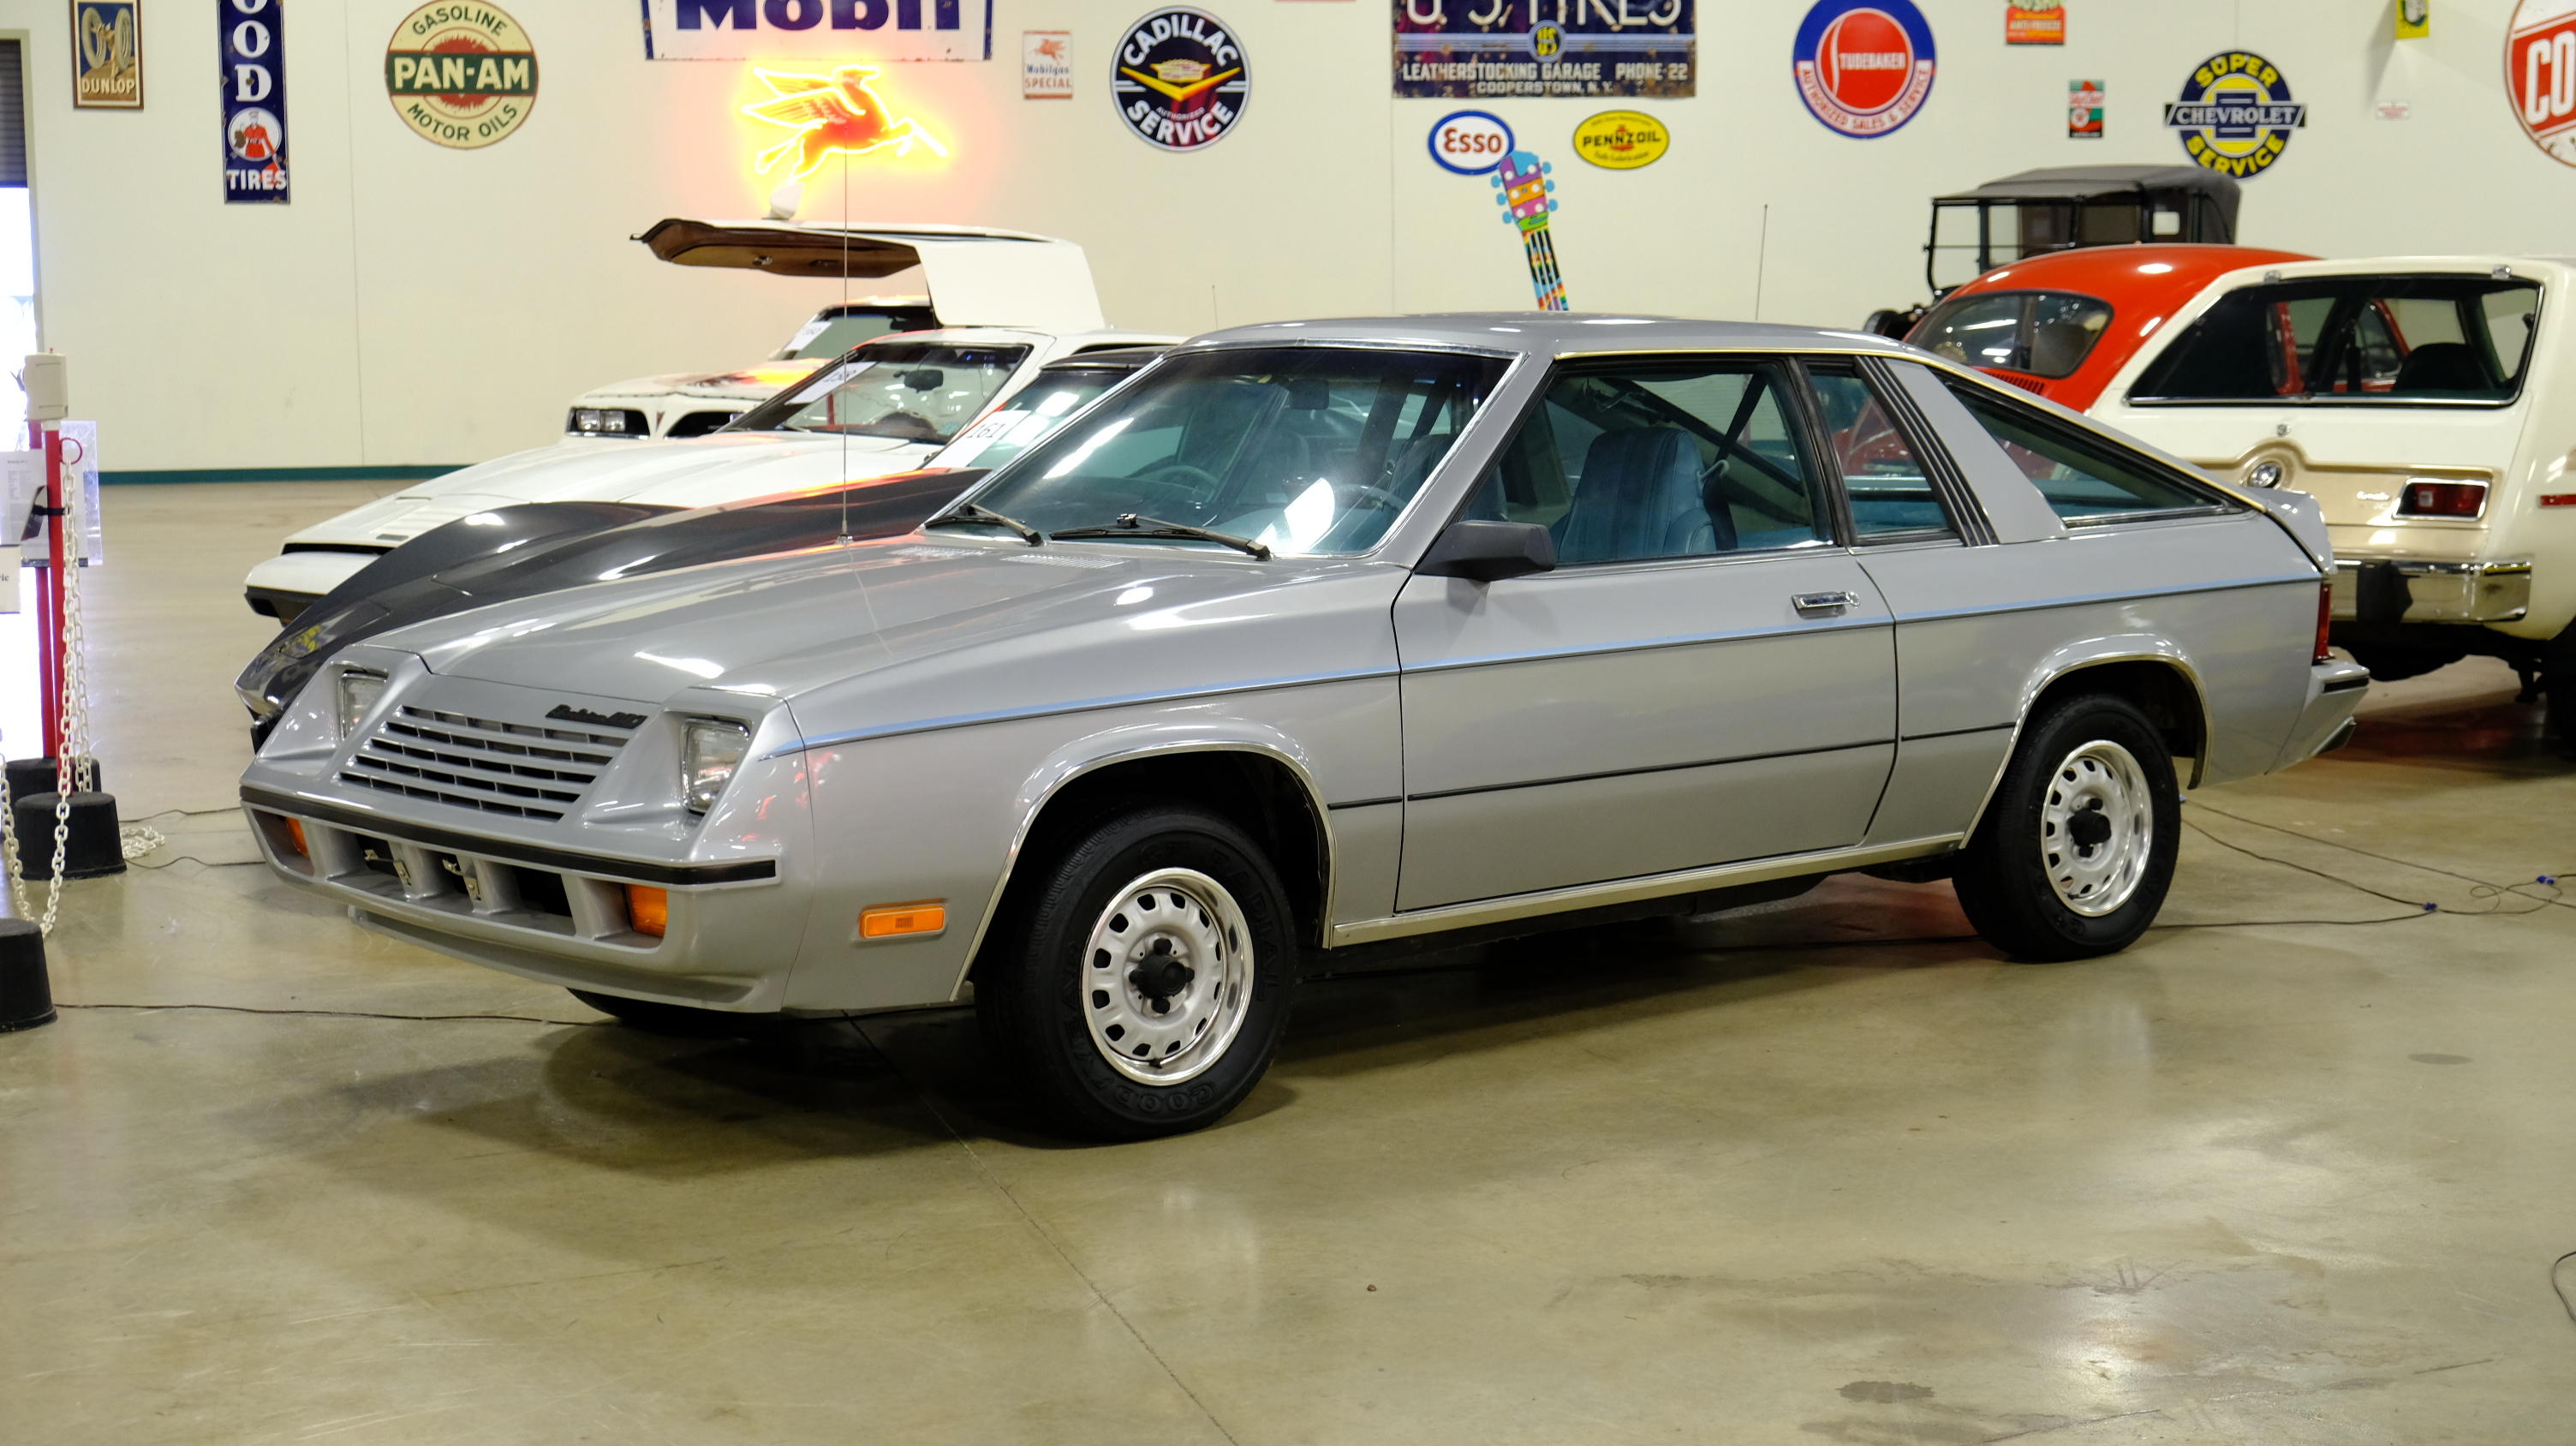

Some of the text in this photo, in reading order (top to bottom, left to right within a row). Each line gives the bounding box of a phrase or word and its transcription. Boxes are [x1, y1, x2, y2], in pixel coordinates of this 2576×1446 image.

[412, 5, 508, 37] GASOLINE
[1124, 14, 1239, 68] CADILLAC
[81, 77, 136, 95] DUNLOP
[394, 57, 530, 90] PAN-AM
[1024, 77, 1071, 89] SPECIAL
[1403, 63, 1537, 81] LEATHERSTOCKING
[1541, 63, 1601, 81] GARAGE
[2194, 52, 2280, 88] SUPER
[1802, 69, 1929, 130] AUTHORIZED SALES & SERVICE
[2175, 106, 2297, 125] CHEVROLET
[407, 103, 517, 141] MOTOR OILS
[1126, 99, 1234, 145] SERVICE
[1583, 130, 1661, 147] PENNZOIL
[2185, 134, 2286, 177] SERVICE
[225, 169, 287, 191] TIRES
